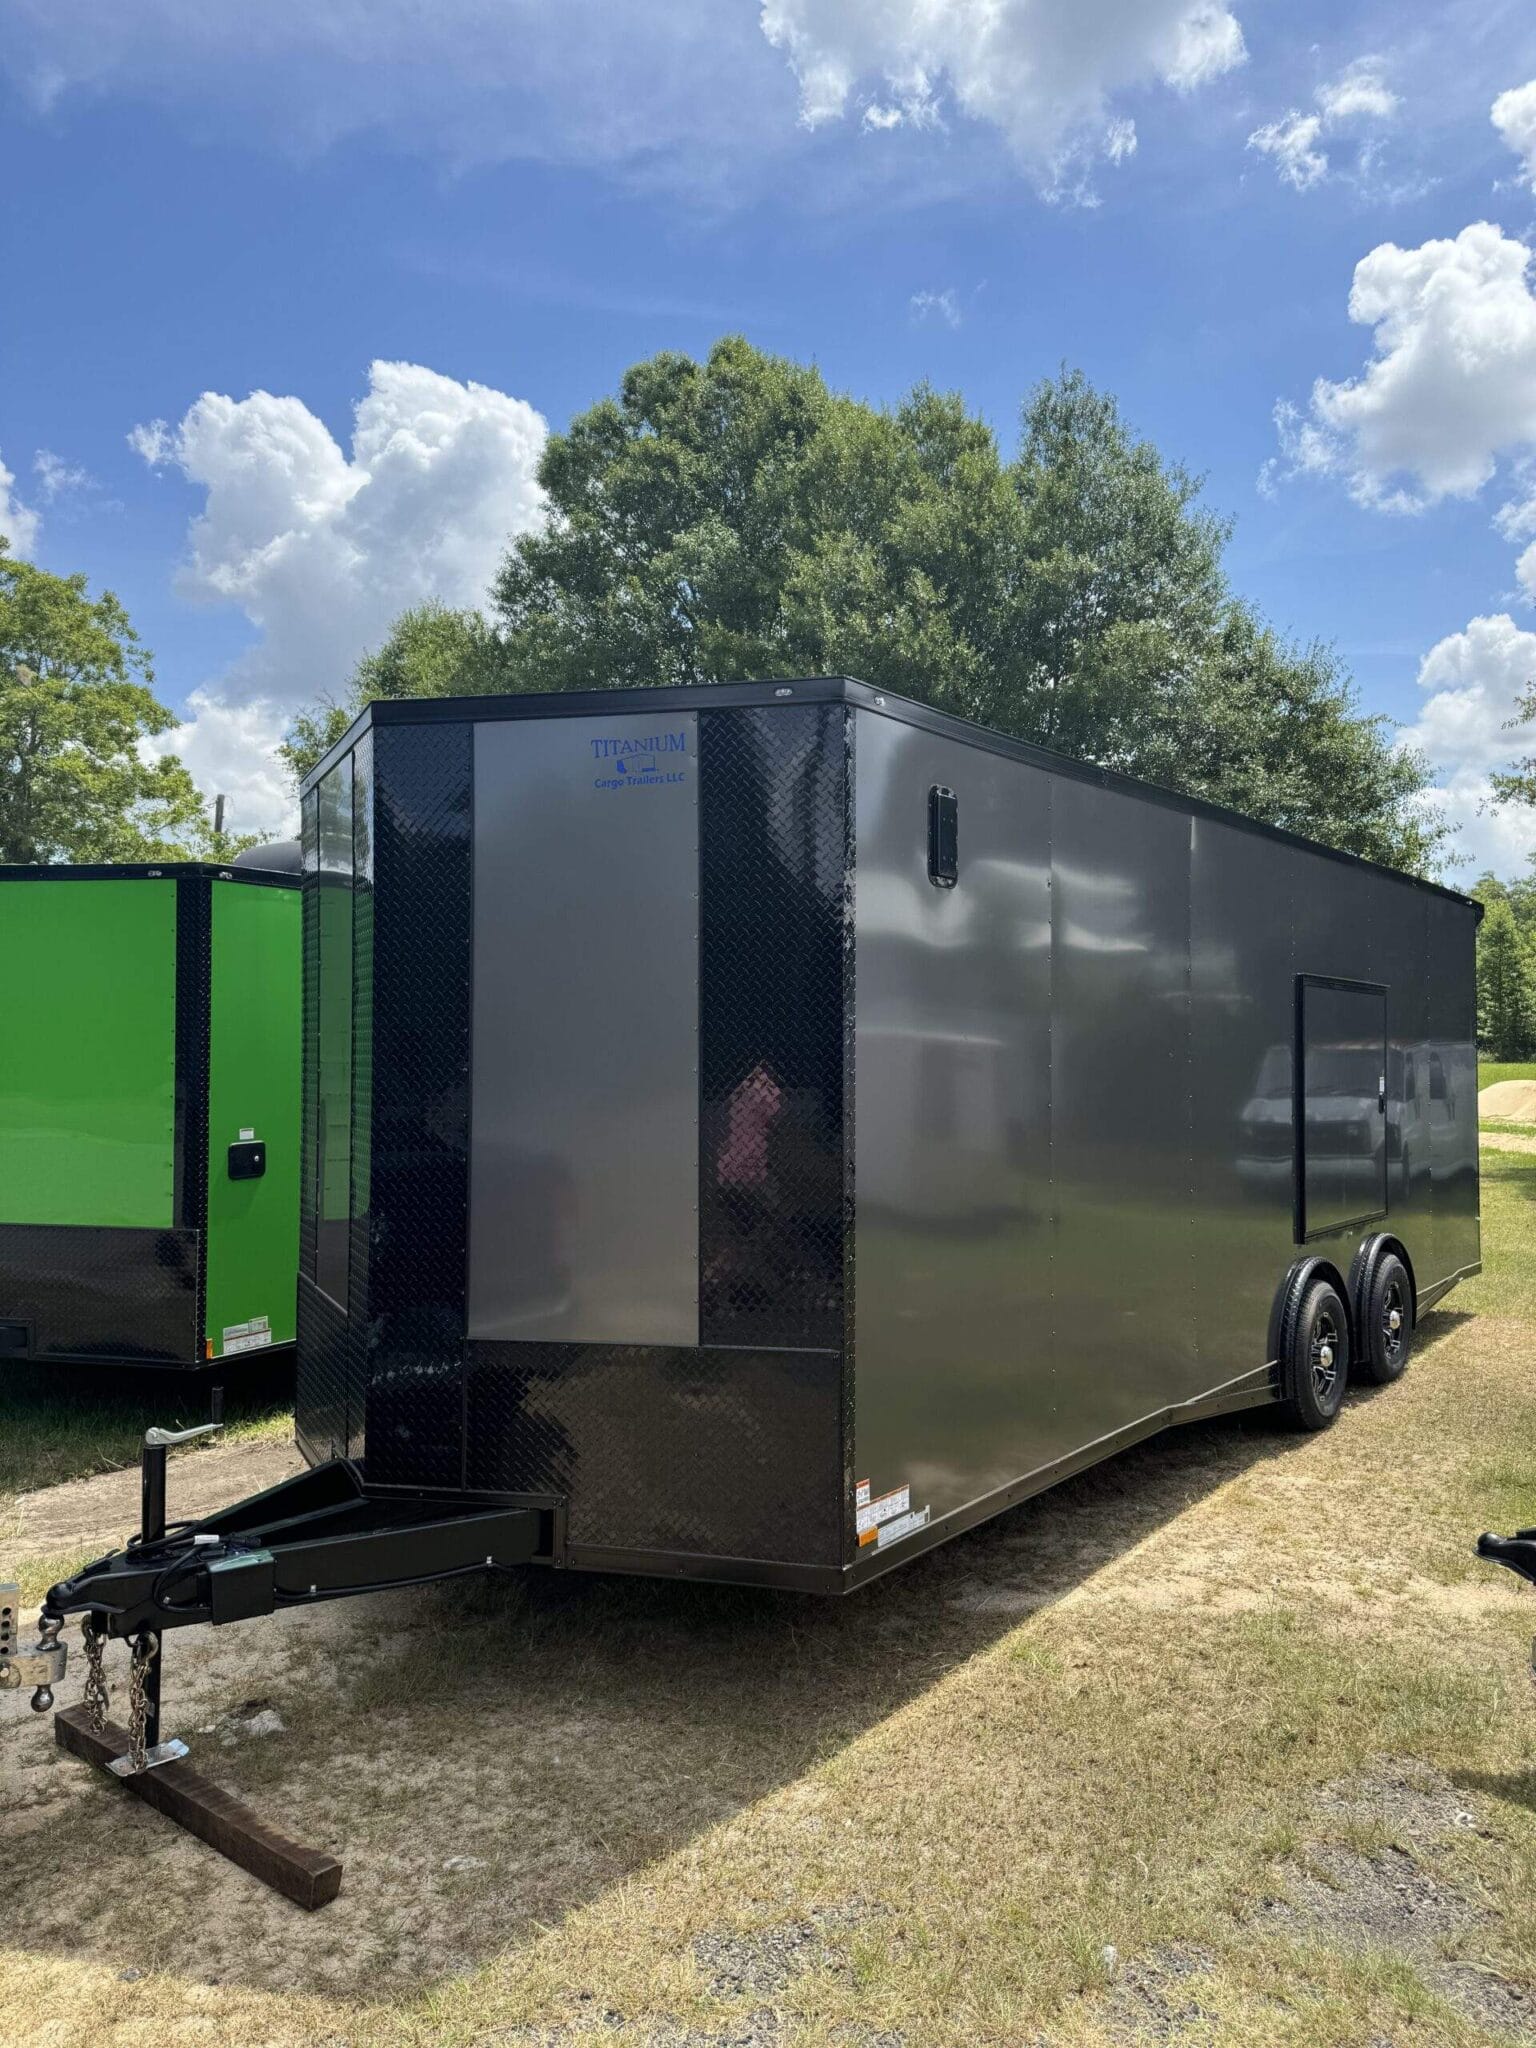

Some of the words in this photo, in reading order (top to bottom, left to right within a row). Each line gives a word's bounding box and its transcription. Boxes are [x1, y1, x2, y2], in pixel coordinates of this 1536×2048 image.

[591, 732, 686, 758] TITANIUM
[594, 778, 624, 789] Cargo
[626, 775, 664, 786] Trailers
[666, 772, 686, 783] LLC
